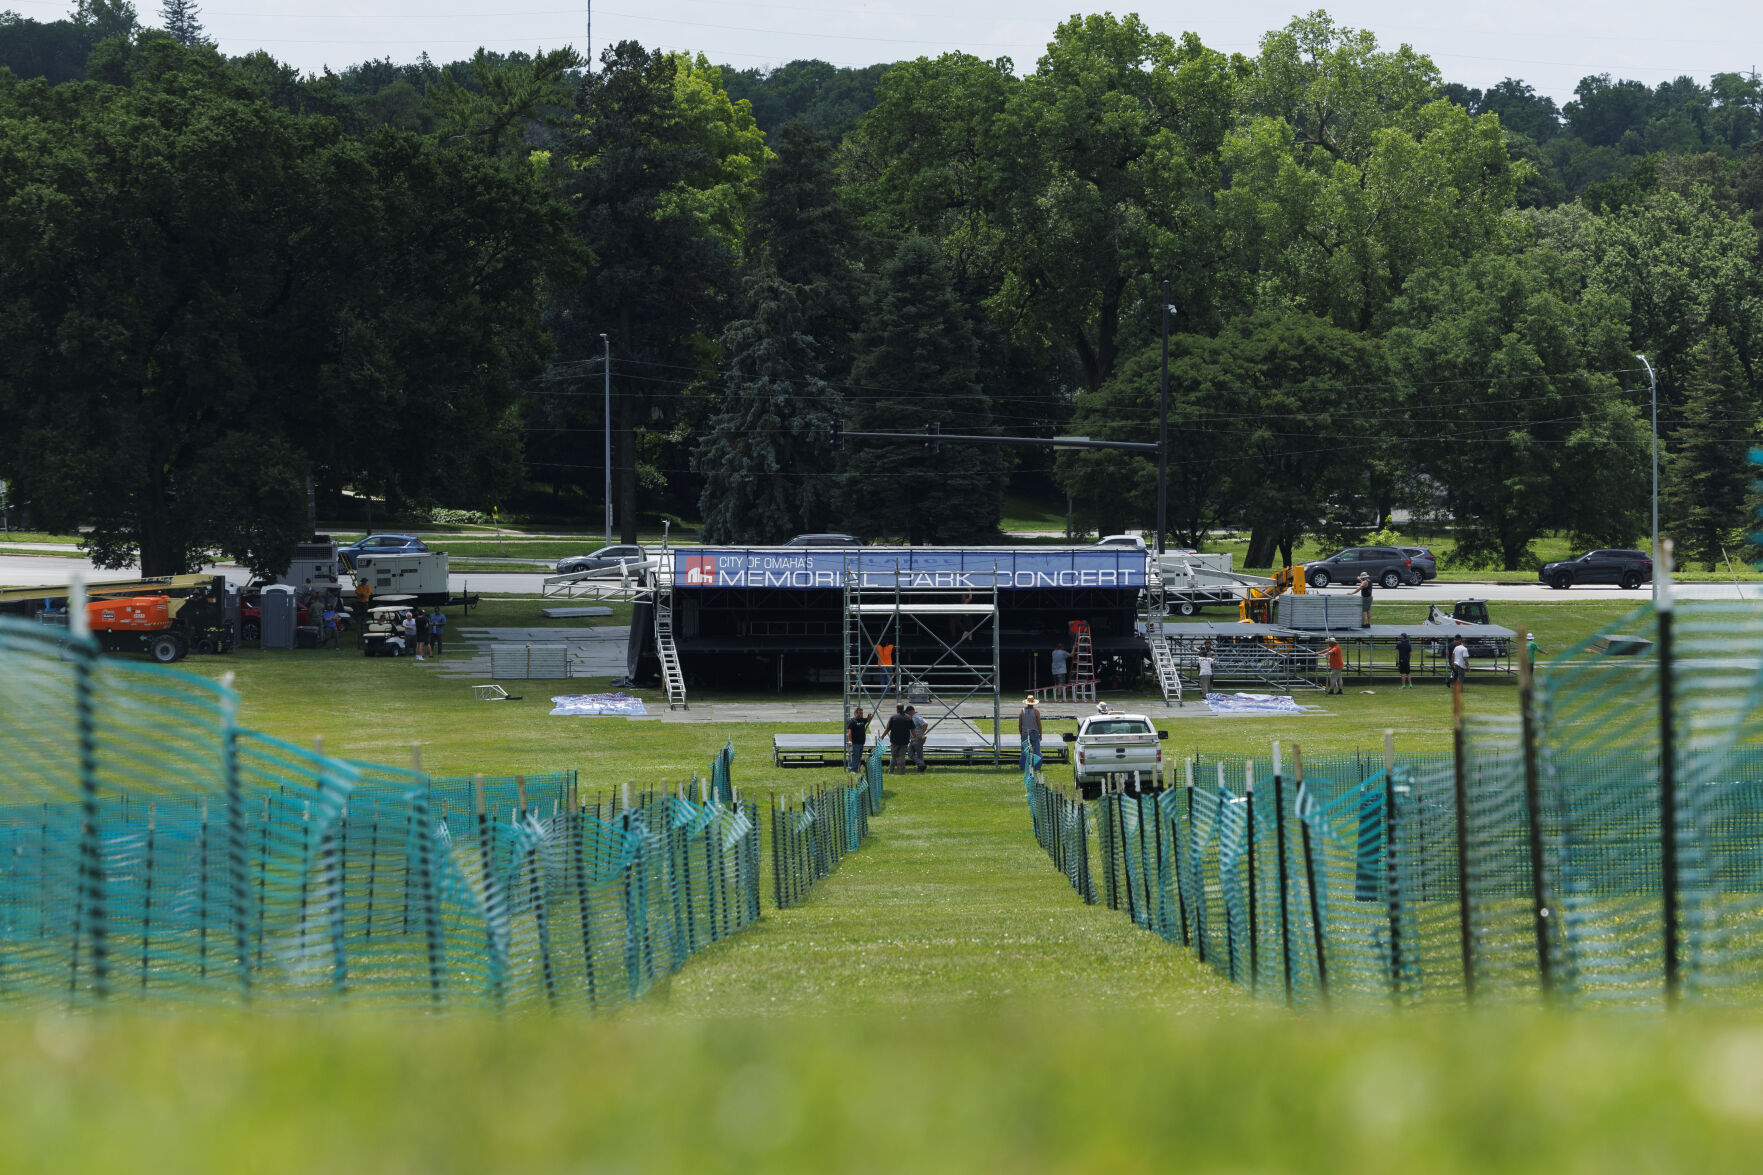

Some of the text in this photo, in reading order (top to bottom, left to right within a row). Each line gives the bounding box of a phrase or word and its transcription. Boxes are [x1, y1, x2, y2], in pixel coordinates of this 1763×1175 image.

[719, 556, 814, 569] CITY OF OMAHA'S
[719, 569, 1136, 588] MEMORIAL PARK CONCERT
